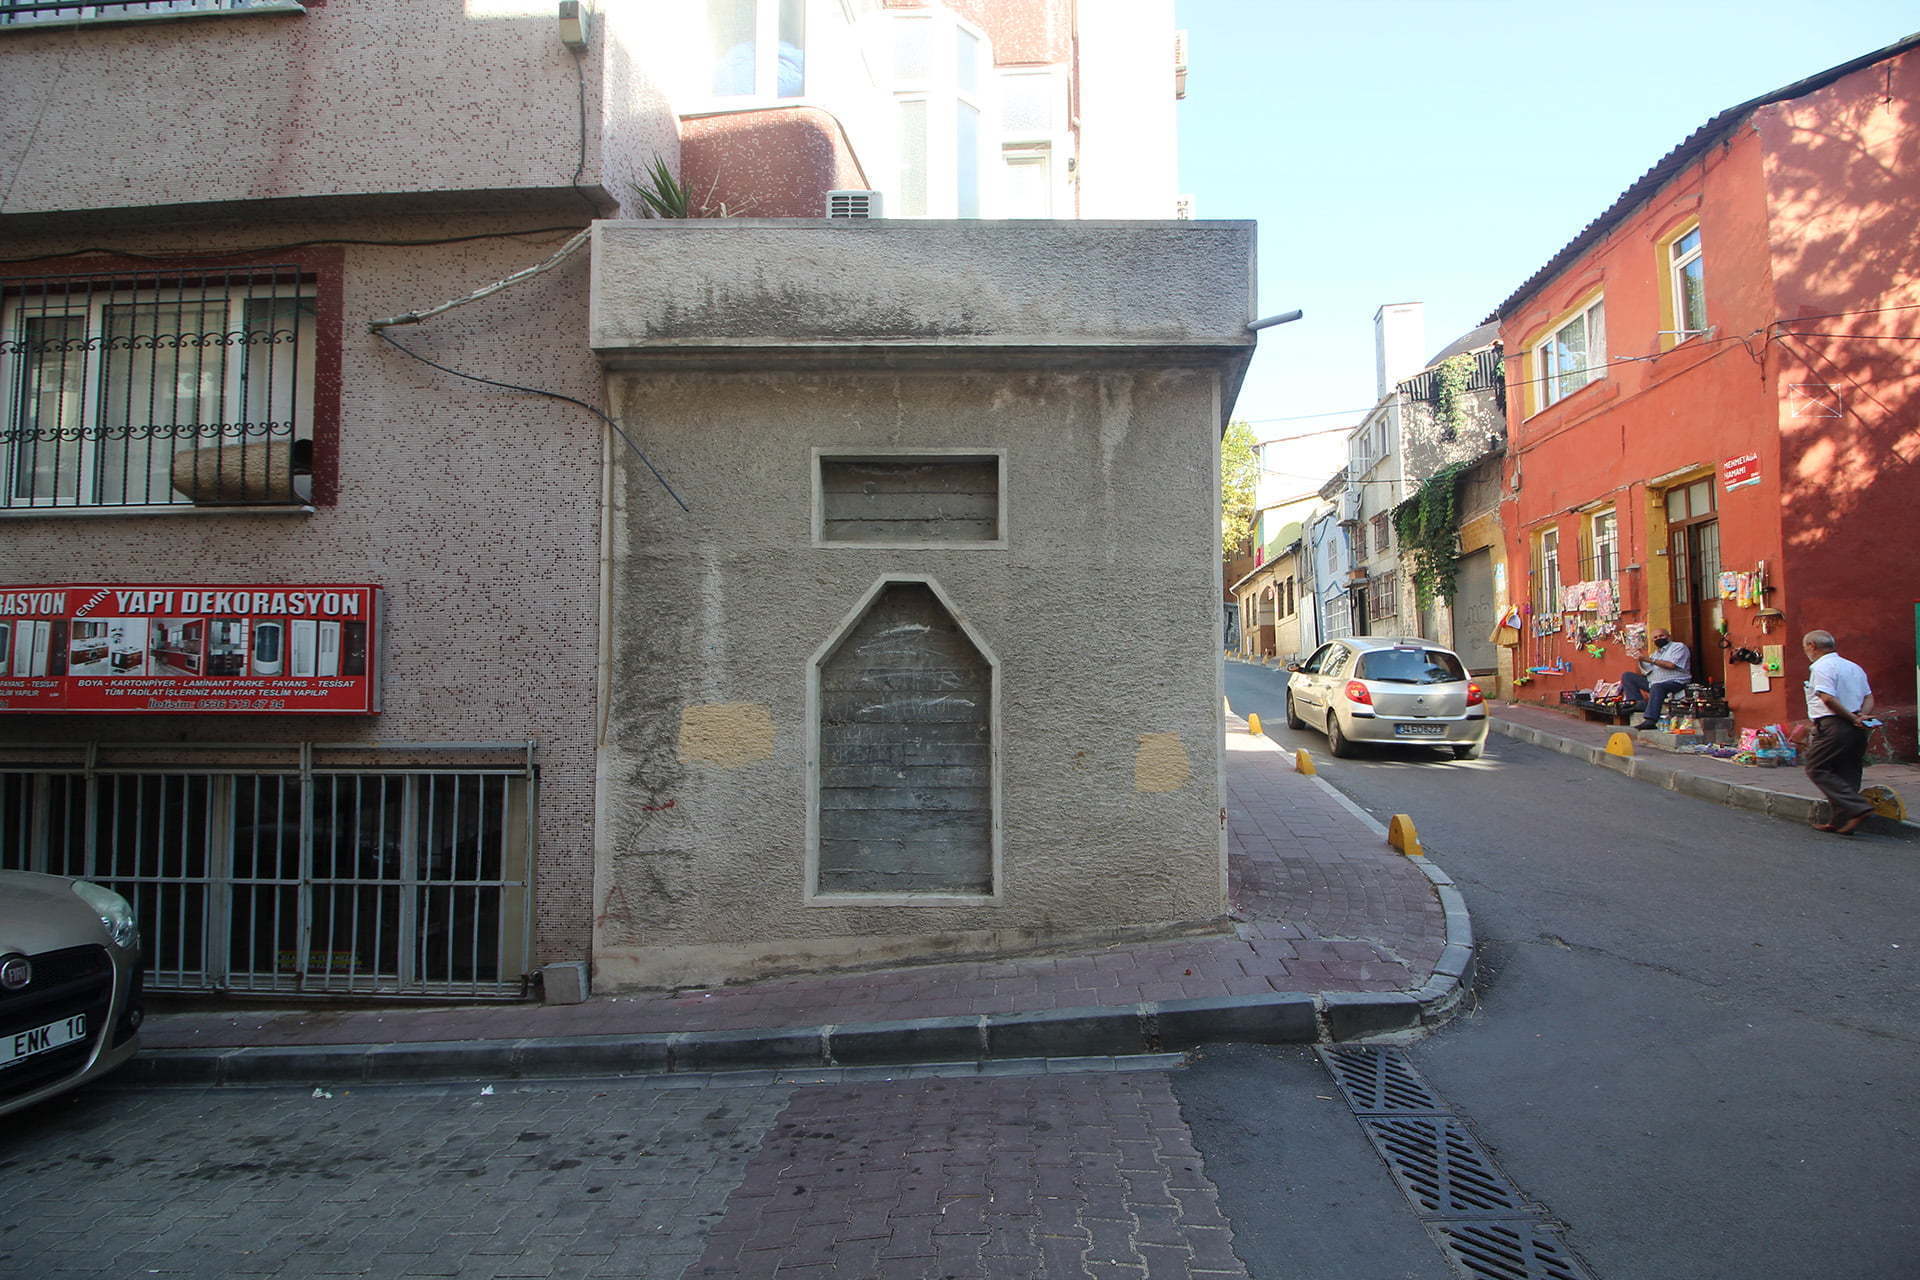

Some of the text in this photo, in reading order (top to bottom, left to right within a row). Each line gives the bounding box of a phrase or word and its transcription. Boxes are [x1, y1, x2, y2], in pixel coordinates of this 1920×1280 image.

[116, 591, 360, 616] YAPI DEKORASYON
[110, 678, 176, 688] KARTONPİYER
[233, 680, 265, 688] PARKE
[272, 680, 307, 688] FAYANS
[318, 680, 356, 688] TESİSAT
[105, 688, 124, 696] TÜM
[127, 687, 163, 697] TADİLAT
[211, 688, 256, 697] ANAHTAR
[294, 688, 328, 697] YAPILIR
[14, 1016, 86, 1057] ENK 10
